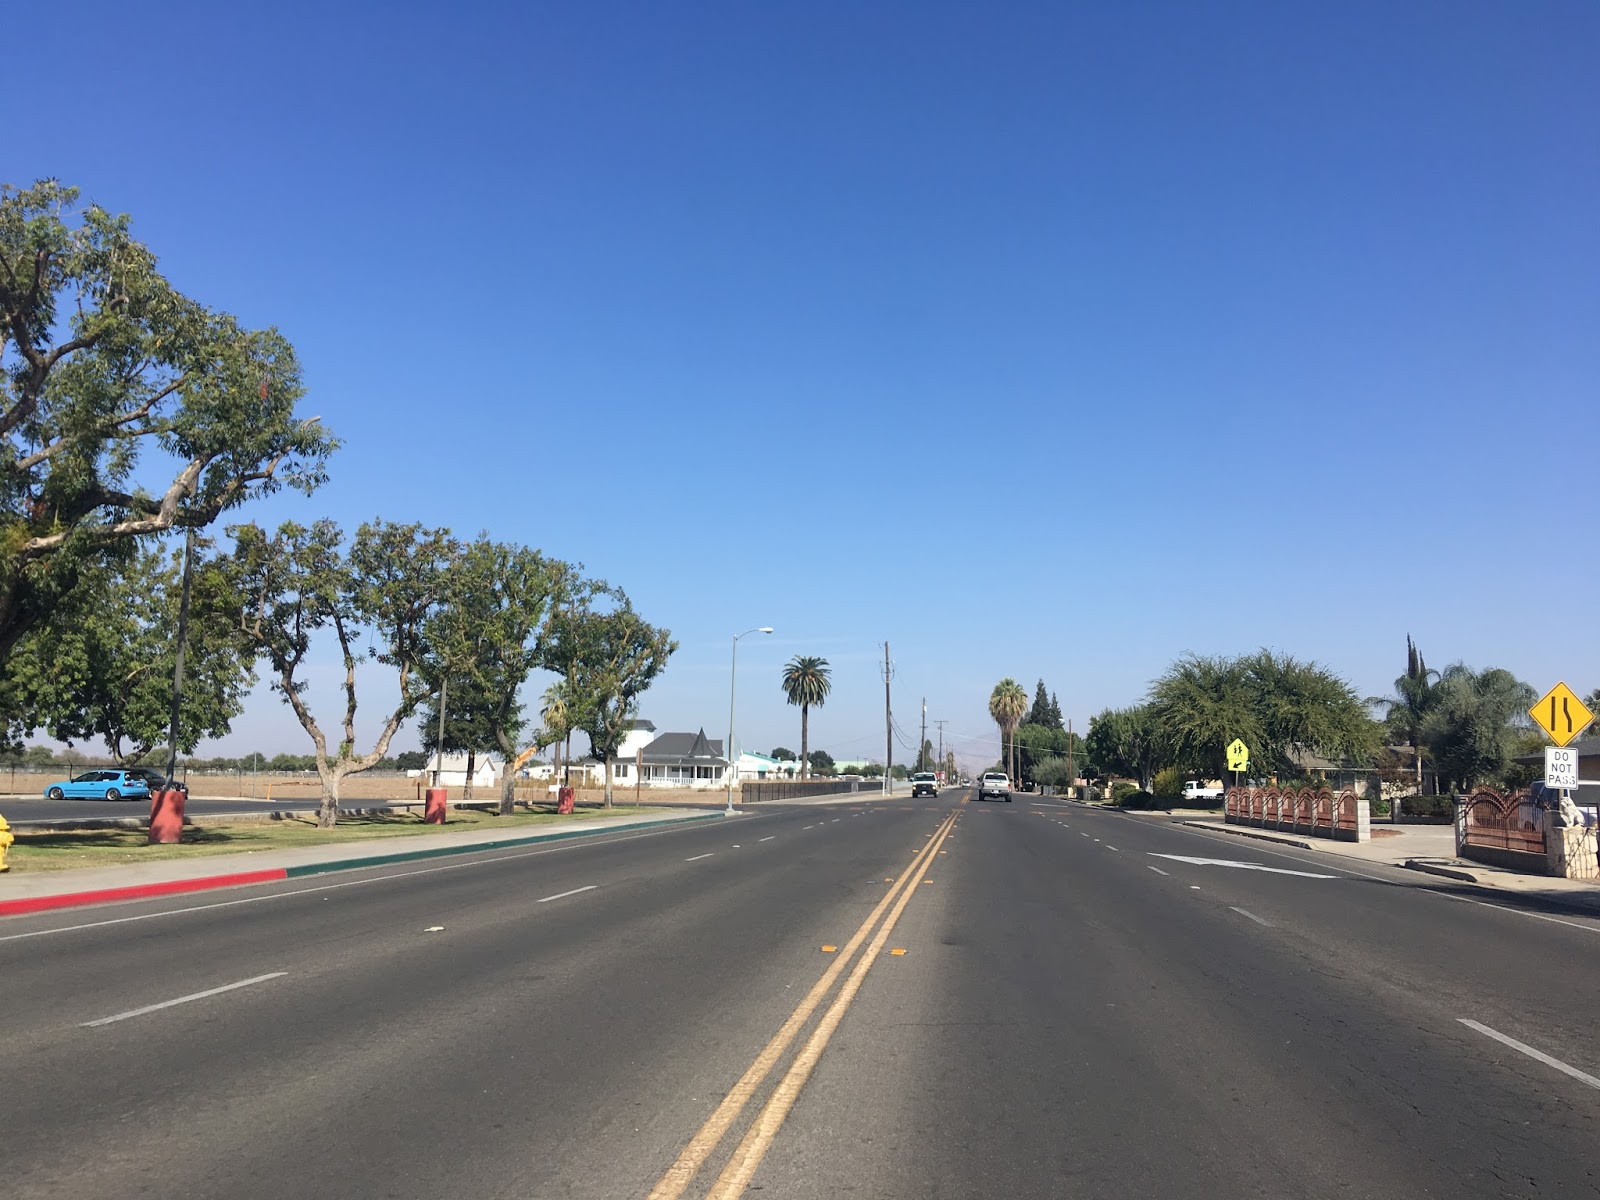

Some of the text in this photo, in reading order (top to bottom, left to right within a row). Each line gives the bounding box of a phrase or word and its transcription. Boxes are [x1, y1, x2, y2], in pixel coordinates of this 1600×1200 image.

[1555, 752, 1569, 761] DO
[1552, 763, 1572, 773] NOT
[1549, 775, 1575, 785] PASS
